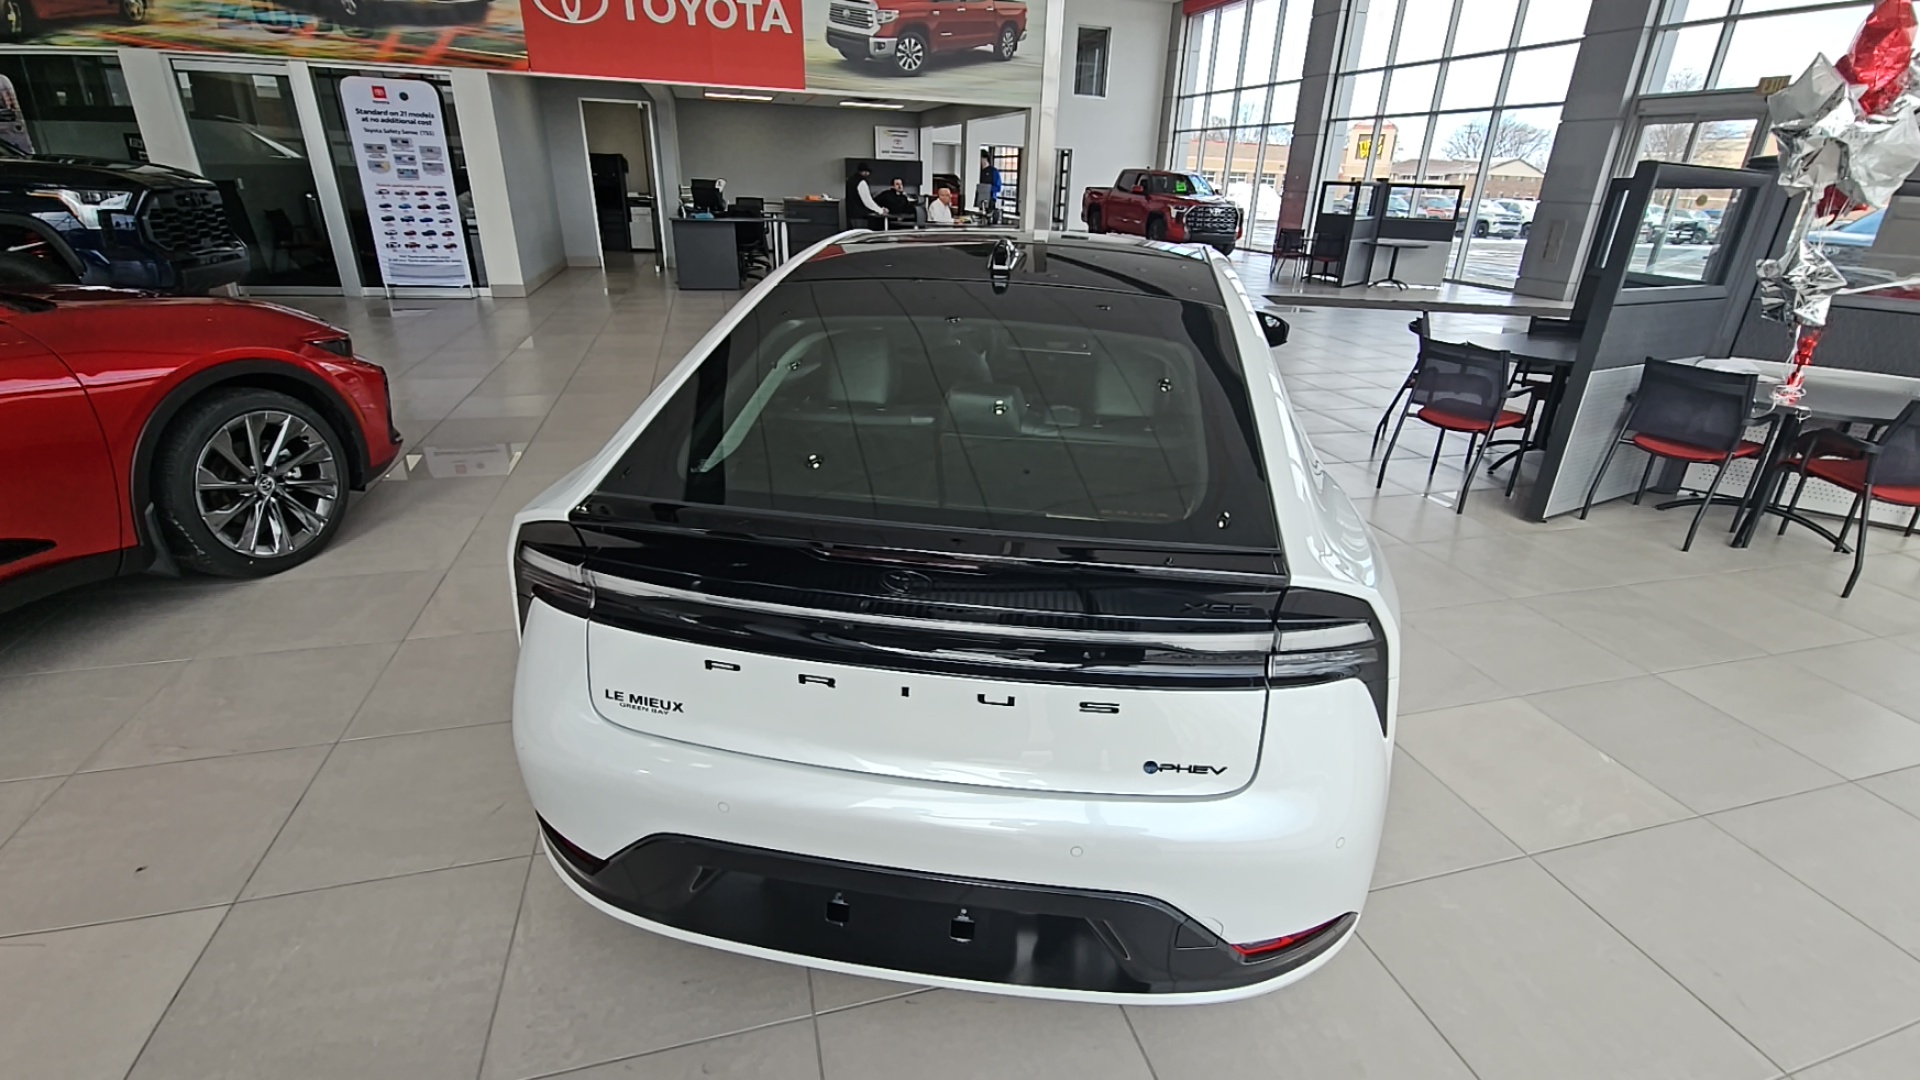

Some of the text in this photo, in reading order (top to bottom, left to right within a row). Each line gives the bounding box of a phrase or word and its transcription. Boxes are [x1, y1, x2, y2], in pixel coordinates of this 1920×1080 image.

[624, 0, 794, 34] TOYOTA
[355, 107, 388, 117] Standard
[400, 110, 408, 118] 21
[408, 111, 435, 119] models
[380, 117, 416, 125] additional
[1182, 603, 1254, 616] XSE
[704, 659, 1120, 714] PRIUS
[605, 688, 685, 714] LE MIEUX
[619, 702, 650, 712] GREEN
[1158, 763, 1228, 776] PHEV
